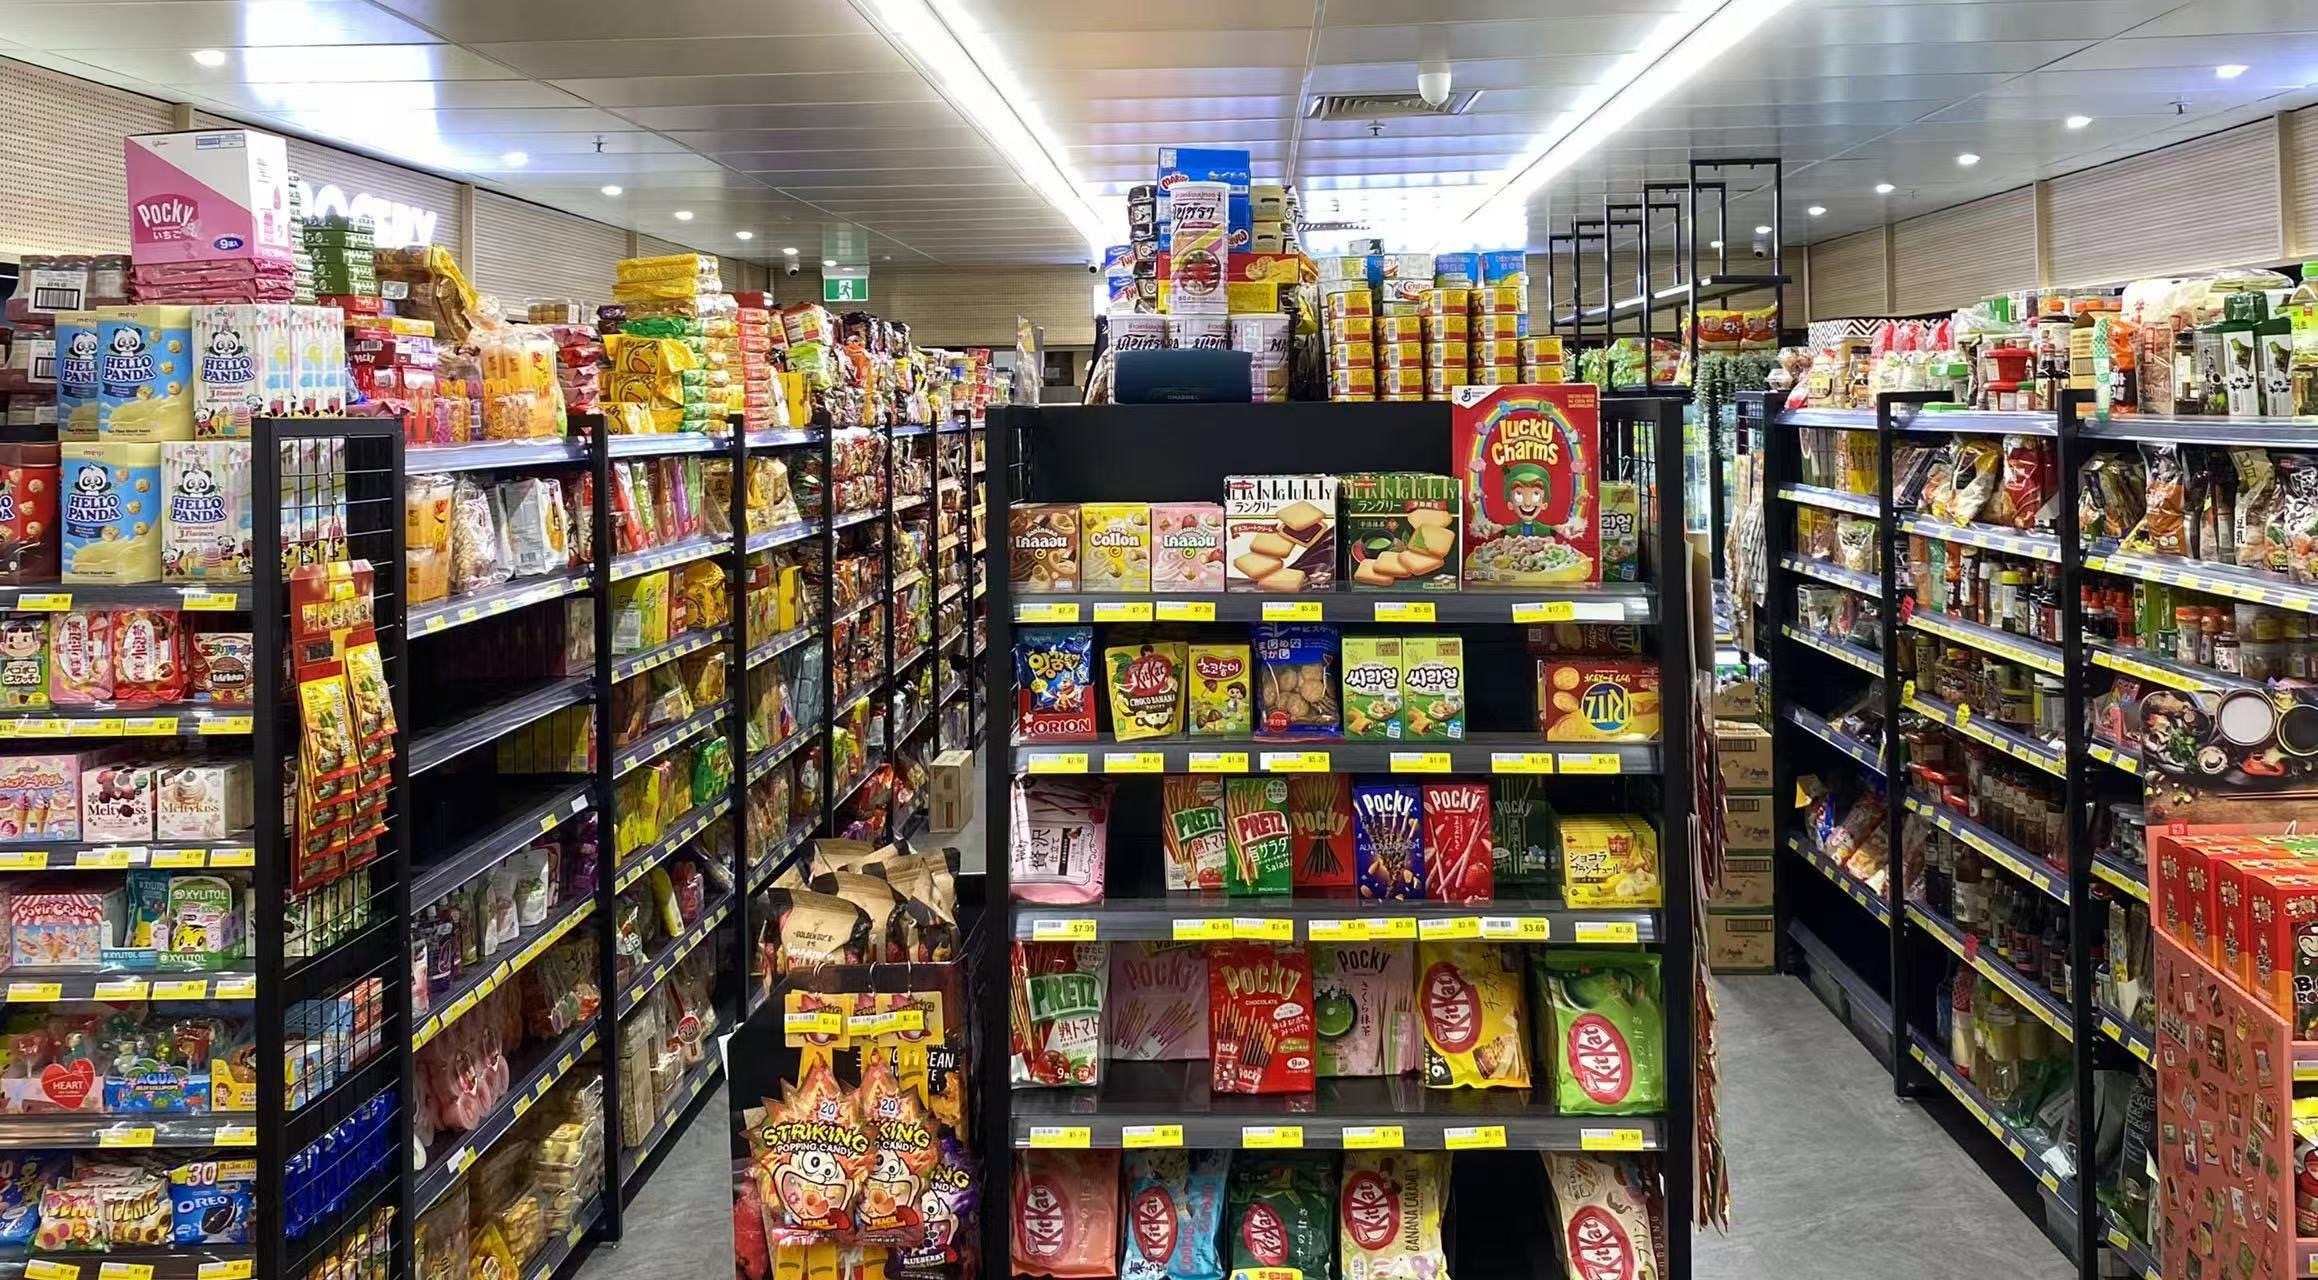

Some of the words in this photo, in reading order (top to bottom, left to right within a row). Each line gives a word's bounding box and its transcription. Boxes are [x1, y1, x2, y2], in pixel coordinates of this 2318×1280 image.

[106, 356, 150, 369] HELLO
[204, 357, 250, 369] HELLO
[104, 367, 154, 380] PANDA
[203, 369, 253, 381] PANDA
[1499, 418, 1554, 444] Lucky
[1491, 438, 1560, 466] Charms
[70, 497, 118, 509] HELLO
[173, 498, 222, 510] HELLO
[1235, 501, 1278, 513] ラングリー
[1357, 500, 1401, 512] ラングリー
[67, 508, 120, 520] PANDA
[172, 509, 225, 521] PANDA
[1090, 534, 1140, 548] Collon
[1346, 667, 1398, 688] 씨리얼
[1406, 667, 1459, 688] 씨리얼
[1585, 688, 1626, 724] RITZ
[1033, 718, 1091, 734] ORION
[88, 804, 147, 818] Meltyiss
[1174, 810, 1224, 839] PRETZ
[1237, 813, 1286, 843] PRETZ
[1569, 850, 1608, 863] ショコラ
[1265, 859, 1290, 873] Salad
[184, 889, 227, 900] XYLITOL
[1523, 923, 1546, 933] $3.69
[109, 951, 137, 959] XYLITOL
[168, 954, 207, 962] XYLITOL
[1029, 974, 1099, 1015] PRETZ
[1430, 973, 1473, 1044] KitKat
[1579, 1024, 1623, 1093] KitKat
[53, 1081, 84, 1090] HEART
[138, 1073, 178, 1085] AQUA
[821, 1102, 836, 1115] 20
[881, 1099, 897, 1113] 20
[763, 1121, 870, 1153] STRIKING
[777, 1143, 818, 1153] POPPING
[819, 1143, 853, 1156] CANDY
[882, 1140, 916, 1153] CANDY
[187, 1163, 218, 1186] 30
[177, 1196, 228, 1214] OREO
[1351, 1179, 1391, 1243] KitKat
[1025, 1184, 1065, 1257] KitKat
[1139, 1194, 1170, 1258] KitKat
[1250, 1204, 1283, 1257] KitKat
[1404, 1209, 1421, 1252] BANANA
